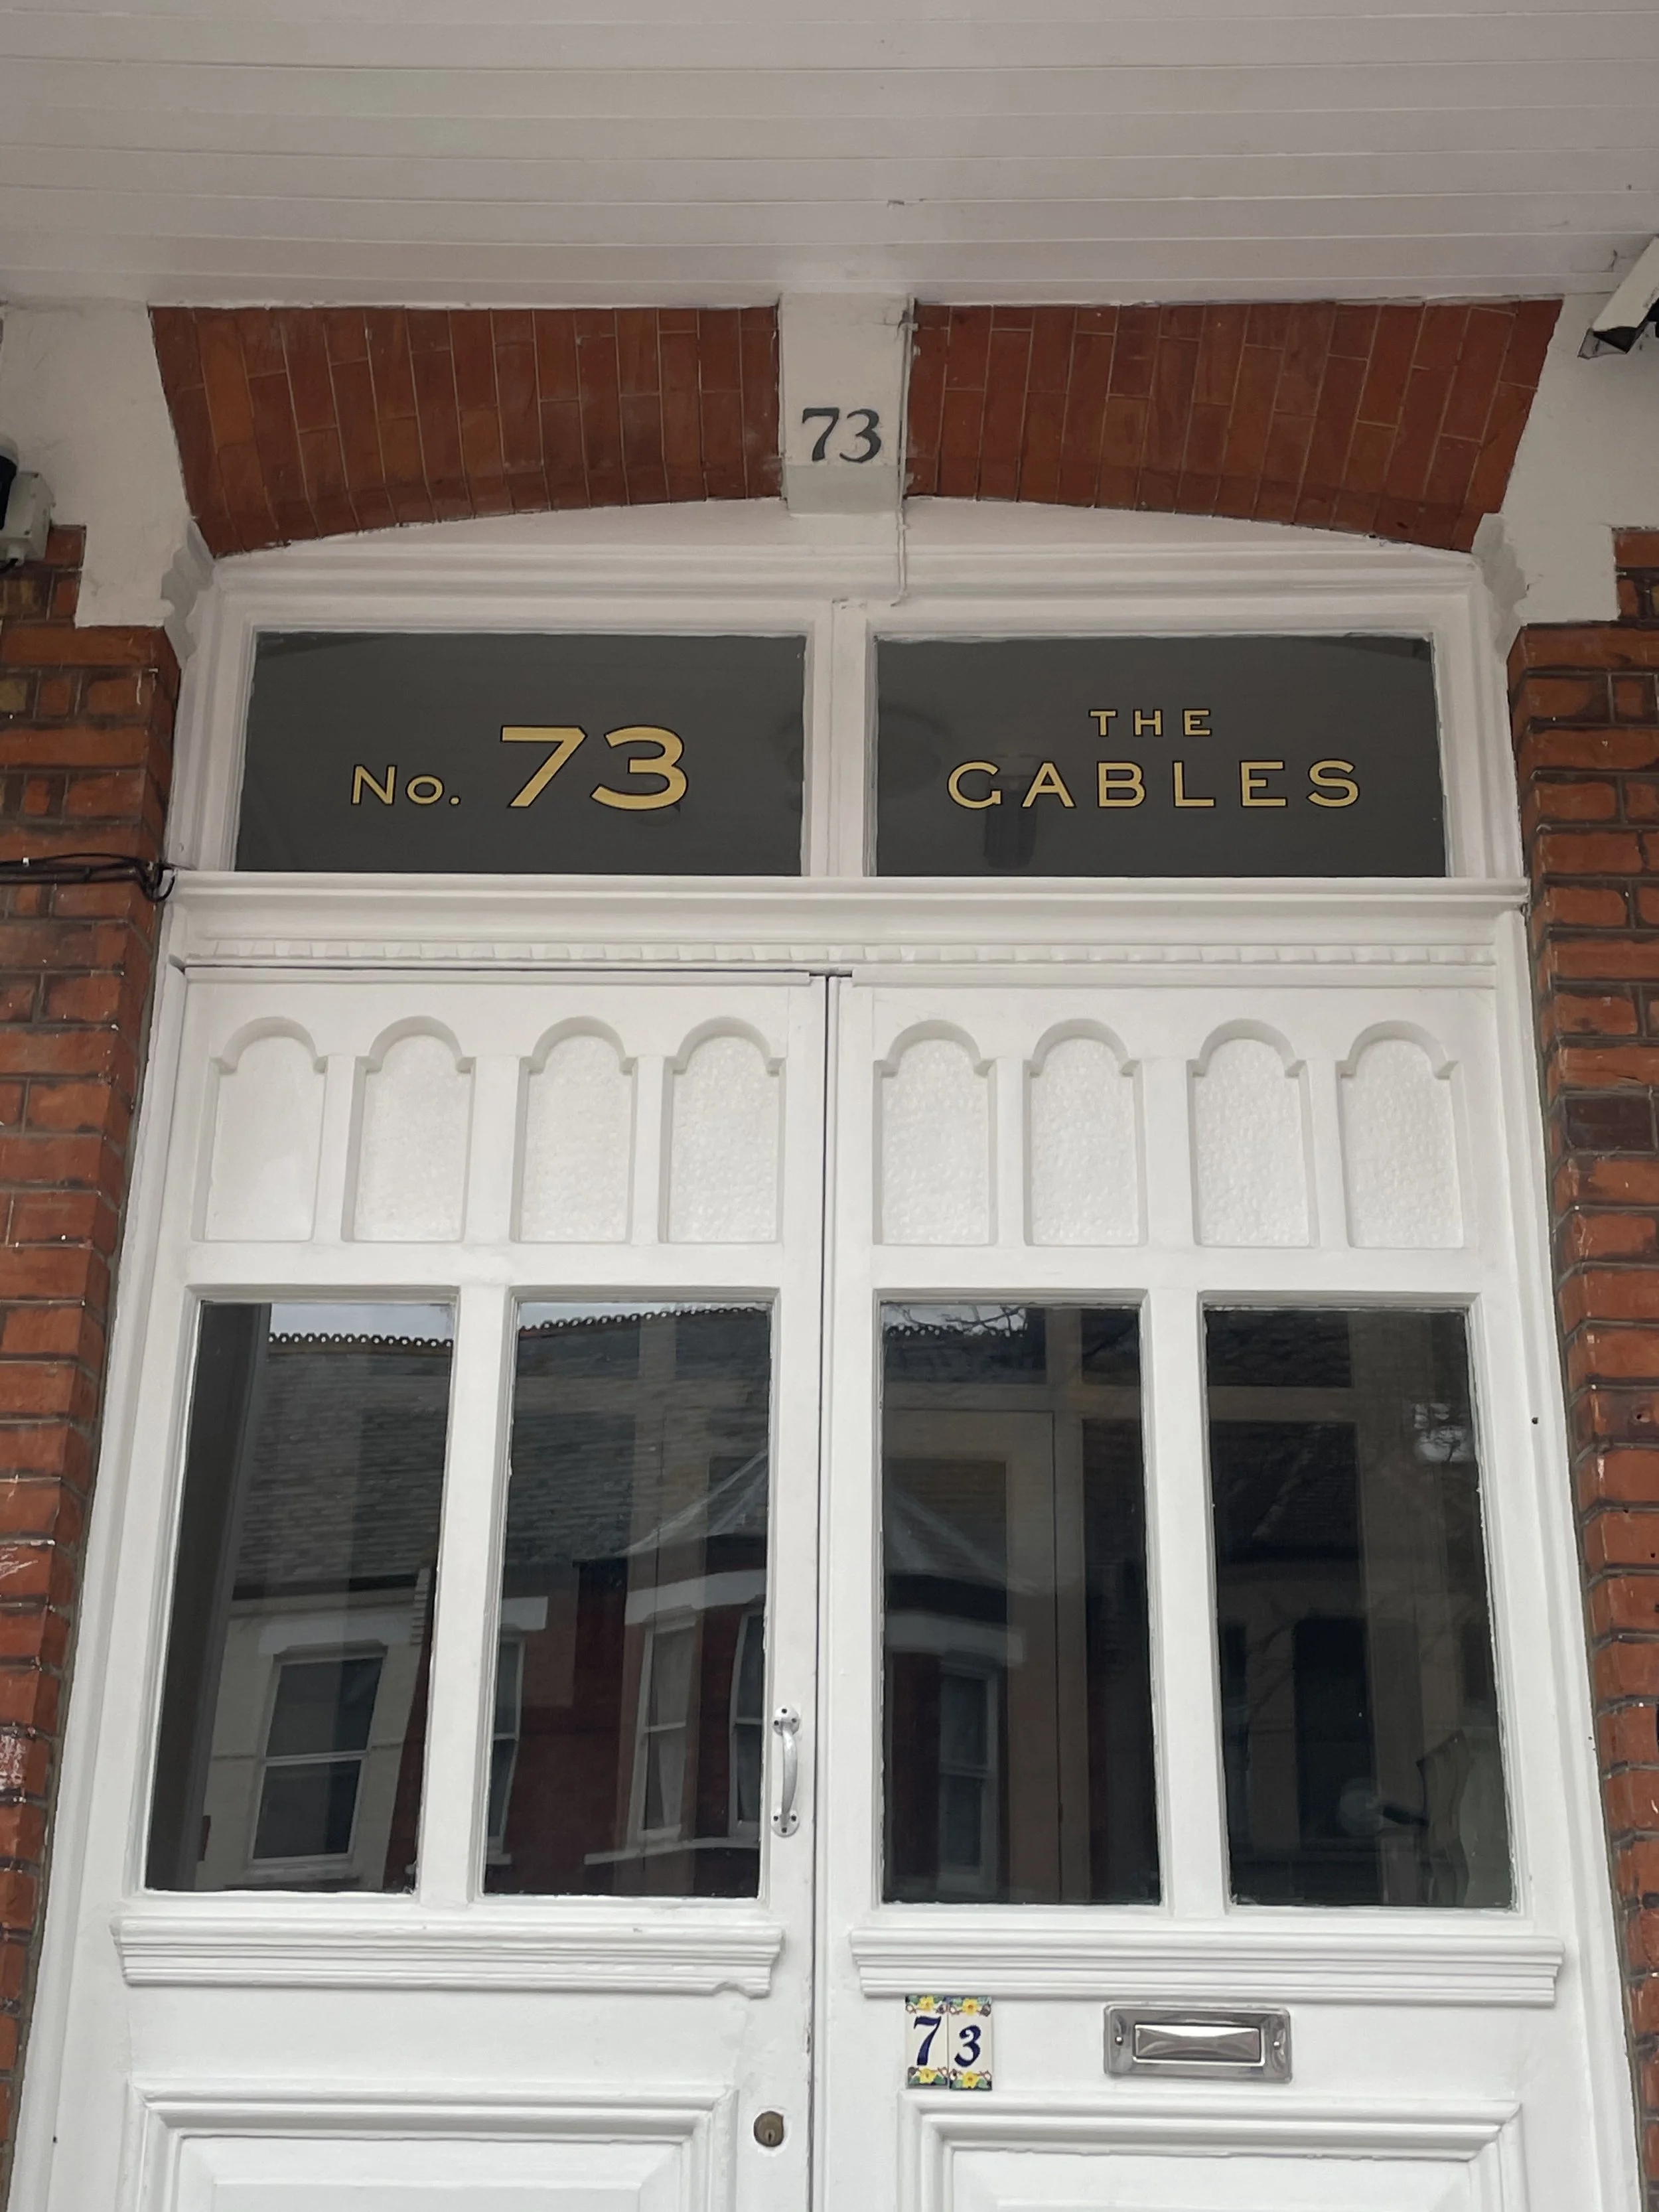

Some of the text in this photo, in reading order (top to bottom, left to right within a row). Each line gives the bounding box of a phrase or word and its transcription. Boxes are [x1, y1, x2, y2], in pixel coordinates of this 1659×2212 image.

[802, 407, 882, 463] 73
[1088, 708, 1213, 737] THE
[350, 724, 689, 811] No. 73
[946, 759, 1360, 810] GABLES
[913, 2015, 982, 2068] 73
